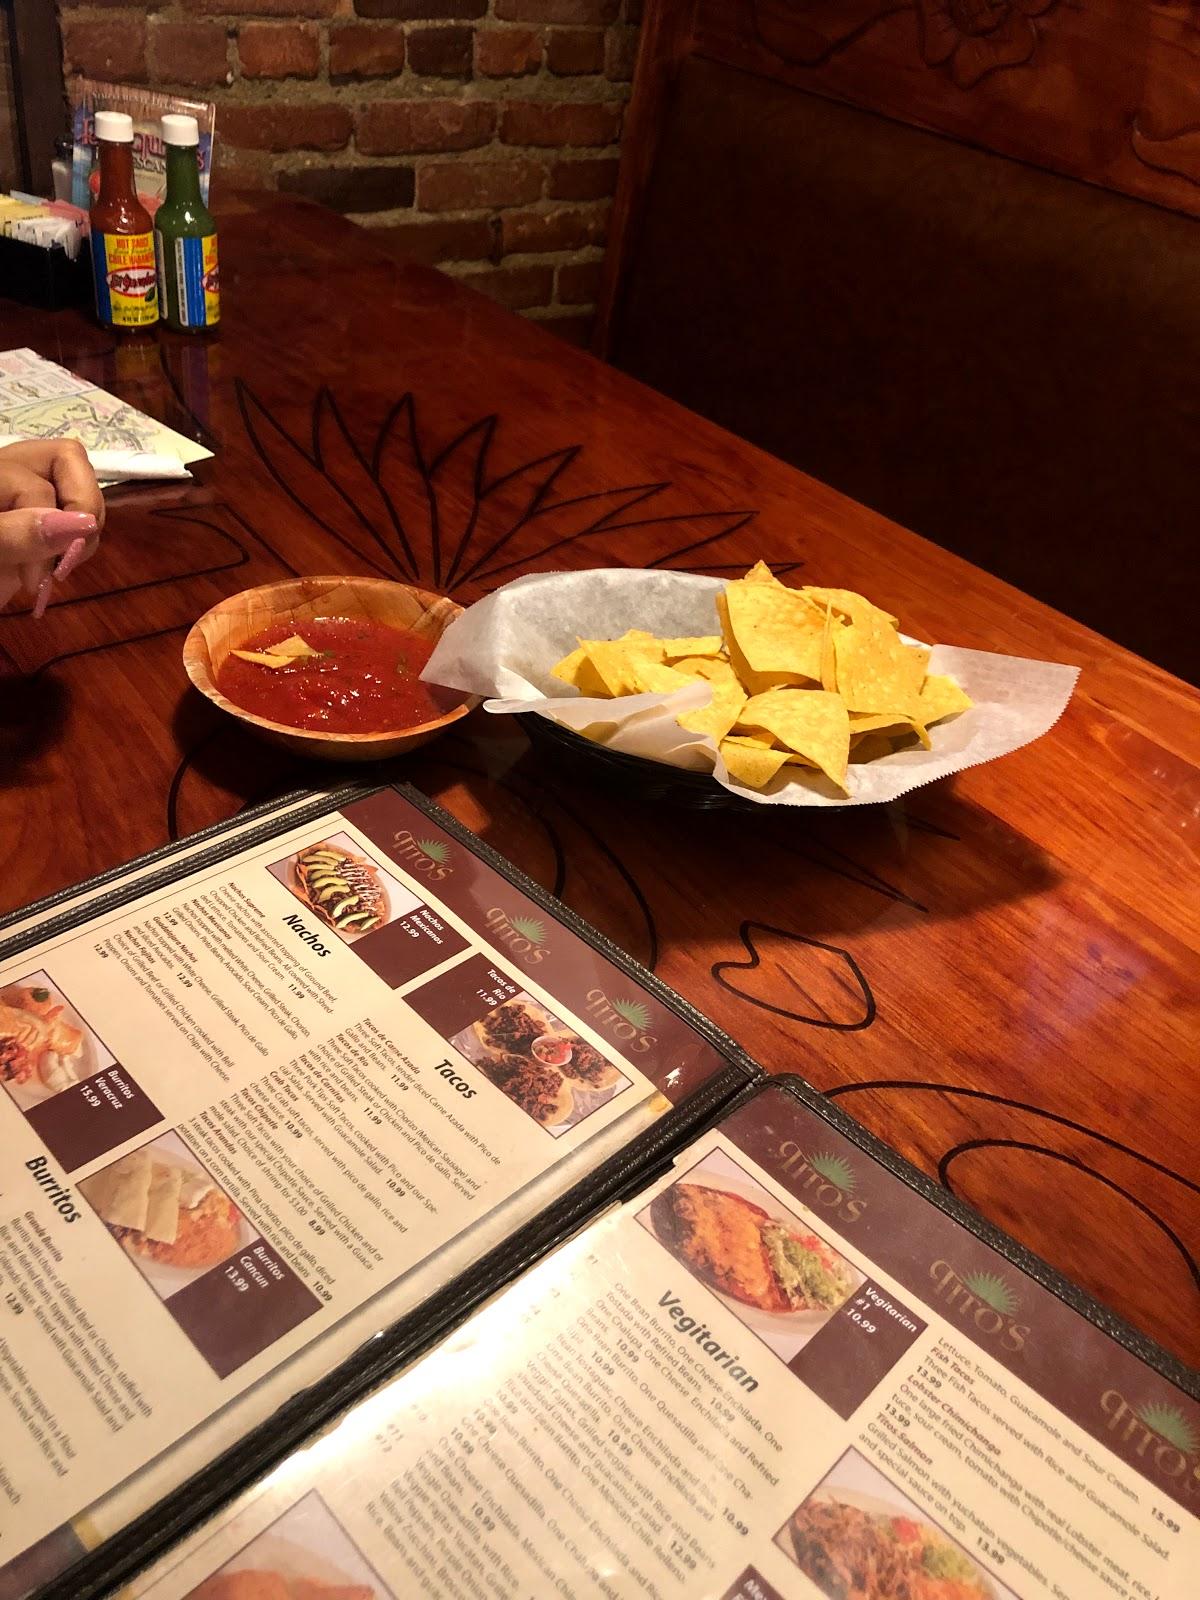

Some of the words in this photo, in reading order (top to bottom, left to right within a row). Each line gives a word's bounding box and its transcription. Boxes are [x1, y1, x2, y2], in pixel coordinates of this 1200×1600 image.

[392, 830, 453, 881] TITO'S
[227, 881, 246, 899] Nachos
[243, 898, 265, 918] Supreme
[162, 911, 178, 926] 12.99
[191, 898, 209, 915] Nachos
[206, 914, 232, 939] Mexicanos
[281, 912, 331, 958] Nachos
[398, 920, 420, 938] 12.99
[409, 914, 443, 944] Mexicanos
[419, 909, 444, 930] Nachos
[92, 943, 109, 958] 12.99
[122, 929, 141, 948] Nachos
[138, 946, 155, 963] Fajitas
[218, 885, 236, 903] Cheese
[233, 902, 252, 918] nachos
[249, 917, 264, 929] with
[259, 927, 283, 948] assorted
[279, 946, 300, 967] topping
[303, 970, 326, 991] Ground
[485, 907, 552, 965] TITO'S
[176, 972, 193, 988] 12.99
[287, 983, 305, 999] 11.99
[486, 969, 505, 984] Tacos
[502, 982, 515, 994] de
[492, 988, 506, 999] Rio
[112, 933, 130, 951] Choice
[131, 954, 150, 972] Grilled
[145, 970, 159, 983] Beef
[160, 987, 180, 1006] Grilled
[175, 1003, 196, 1026] Chicken
[193, 1025, 215, 1045] cooked
[210, 1044, 225, 1057] with
[220, 1055, 234, 1067] Bell
[475, 988, 497, 1006] 11.99
[584, 989, 658, 1053] TITO'S
[335, 1033, 352, 1049] Tacos
[349, 1047, 359, 1057] de
[356, 1055, 368, 1066] Rio
[344, 1027, 360, 1043] Gallo
[357, 1042, 372, 1054] and
[389, 1073, 409, 1091] 11.99
[362, 1018, 379, 1034] Tacos
[376, 1032, 387, 1041] de
[384, 1039, 403, 1057] Carne
[400, 1055, 420, 1074] Azada
[93, 1076, 123, 1109] Veracruz
[106, 1069, 134, 1099] Burritos
[269, 1070, 285, 1086] Crab
[281, 1084, 298, 1101] Tacos
[298, 1054, 315, 1071] Tacos
[312, 1069, 322, 1079] de
[319, 1077, 344, 1103] Carnitas
[353, 1023, 370, 1039] Three
[367, 1037, 382, 1050] Soft
[394, 1064, 415, 1084] tender
[412, 1082, 431, 1099] diced
[427, 1096, 447, 1115] Carne
[444, 1113, 465, 1132] Azada
[462, 1130, 480, 1145] with
[476, 1142, 492, 1157] Pico
[489, 1155, 500, 1165] de
[433, 1058, 476, 1100] Tacos
[78, 1084, 102, 1108] 15.99
[239, 1087, 256, 1105] Tacos
[253, 1103, 278, 1130] Chipotle
[249, 1082, 269, 1103] cheese
[283, 1120, 303, 1139] 10.99
[198, 1111, 215, 1129] Tacos
[212, 1127, 237, 1154] Arandas
[362, 1107, 382, 1125] 11.99
[24, 1154, 81, 1224] Burritos
[228, 1093, 246, 1112] Three
[243, 1110, 259, 1125] Soft
[254, 1122, 271, 1141] Tacos
[268, 1140, 285, 1155] with
[279, 1154, 296, 1169] your
[293, 1168, 315, 1190] choice
[311, 1188, 323, 1197] of
[318, 1194, 342, 1217] Grilled
[337, 1215, 364, 1242] Chicken
[360, 1240, 377, 1255] and
[372, 1253, 382, 1262] or
[385, 1178, 406, 1197] 10.99
[23, 1210, 45, 1238] Grande
[41, 1235, 63, 1262] Burrito
[308, 1219, 325, 1236] 8.99
[223, 1265, 249, 1292] 13.99
[238, 1254, 268, 1288] Cancun
[252, 1245, 284, 1280] Burritos
[4, 1292, 24, 1315] 12.99
[311, 1280, 332, 1302] 10.99
[855, 1296, 870, 1310] #1
[846, 1307, 876, 1334] 10.99
[864, 1286, 916, 1332] Vegitarian
[604, 1290, 635, 1322] Tostada
[632, 1319, 654, 1340] with
[649, 1336, 681, 1368] Refried
[709, 1396, 735, 1422] 10.99
[615, 1338, 640, 1363] 10.99
[658, 1289, 761, 1393] Vegitarian
[590, 1350, 615, 1376] 10.99
[613, 1281, 632, 1301] One
[629, 1297, 651, 1320] Bean
[676, 1344, 696, 1365] One
[693, 1360, 725, 1394] Cheese
[762, 1429, 783, 1453] One
[915, 1365, 942, 1389] 13.99
[930, 1345, 951, 1365] Fish
[949, 1361, 974, 1385] Tacos
[884, 1402, 911, 1428] 13.99
[907, 1373, 941, 1405] Lobster
[939, 1400, 1001, 1456] Chimichanga
[606, 1428, 634, 1457] 10.99
[875, 1411, 899, 1435] Titos
[897, 1431, 933, 1466] Salmon
[923, 1355, 948, 1379] Three
[947, 1375, 968, 1395] Fish
[966, 1390, 992, 1415] Tacos
[990, 1412, 1024, 1441] served
[1022, 1438, 1046, 1459] with
[1043, 1454, 1066, 1476] Rice
[1064, 1473, 1087, 1493] and
[1085, 1487, 1141, 1537] Guacamole
[1008, 1393, 1062, 1441] Guacamole
[1061, 1438, 1083, 1457] and
[1082, 1453, 1105, 1476] Sour
[1150, 1506, 1180, 1534] 15.99
[470, 1500, 496, 1533] 10.99
[721, 1506, 750, 1537] 10.99
[668, 1538, 698, 1571] 12.99
[976, 1536, 1005, 1565] 13.99
